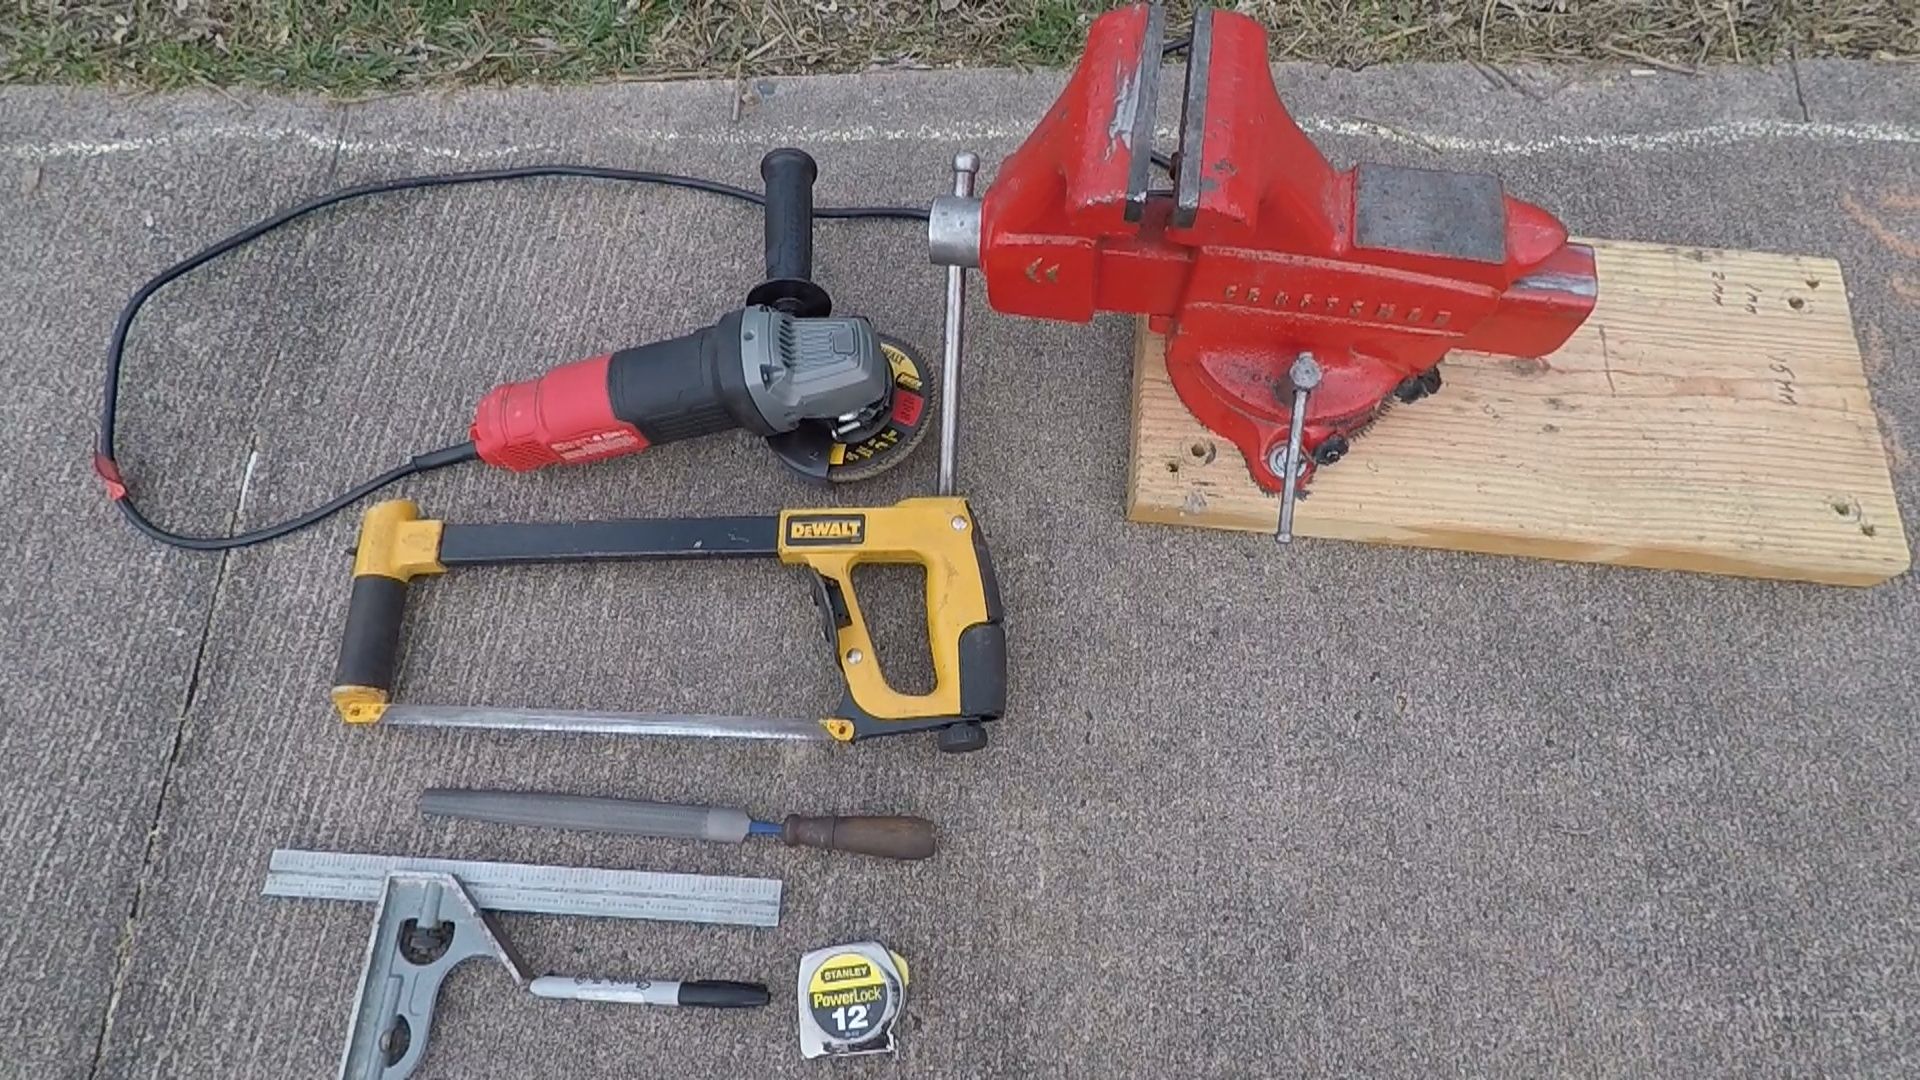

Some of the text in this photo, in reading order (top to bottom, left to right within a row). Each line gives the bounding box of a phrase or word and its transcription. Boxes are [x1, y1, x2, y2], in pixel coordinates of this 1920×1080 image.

[791, 520, 861, 539] DEWALT
[823, 965, 868, 981] STANLEY
[813, 986, 882, 1009] PowerLock
